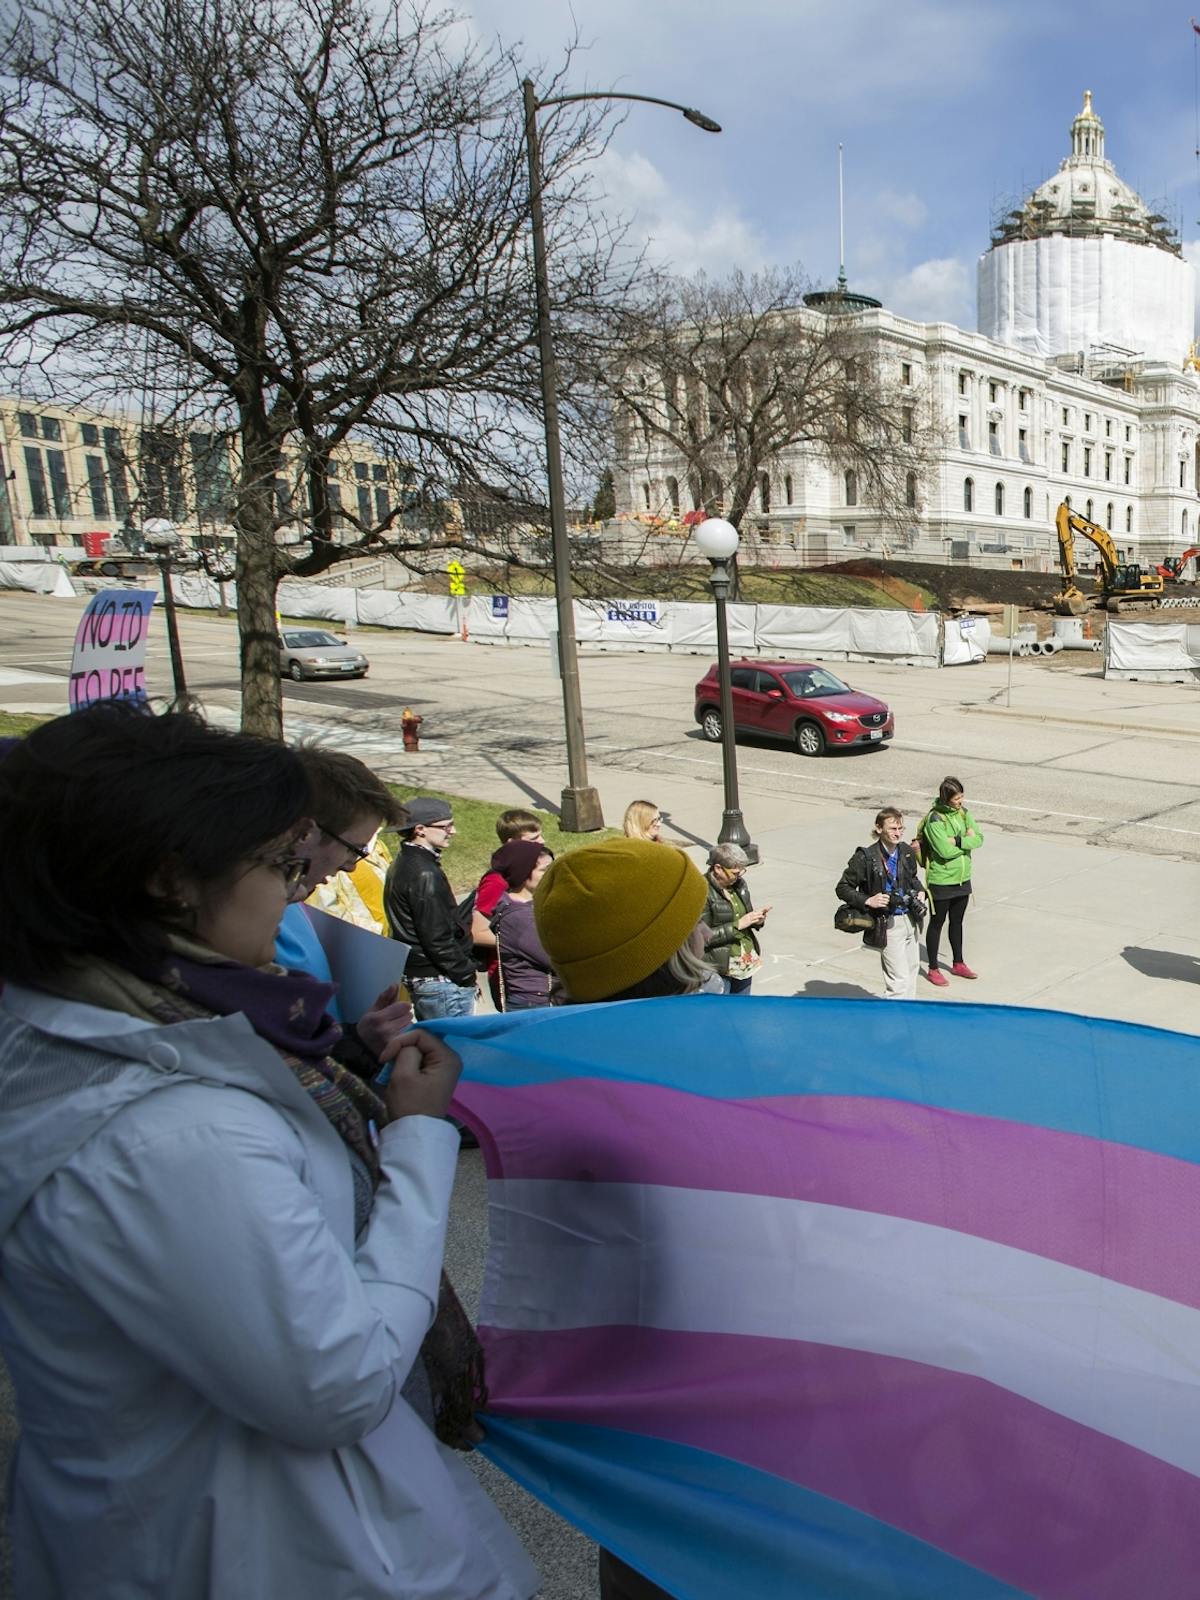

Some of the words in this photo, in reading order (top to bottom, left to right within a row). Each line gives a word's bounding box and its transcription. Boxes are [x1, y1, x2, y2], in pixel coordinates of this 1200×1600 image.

[81, 600, 116, 652] NO
[115, 601, 143, 650] ID
[71, 671, 102, 706] TO
